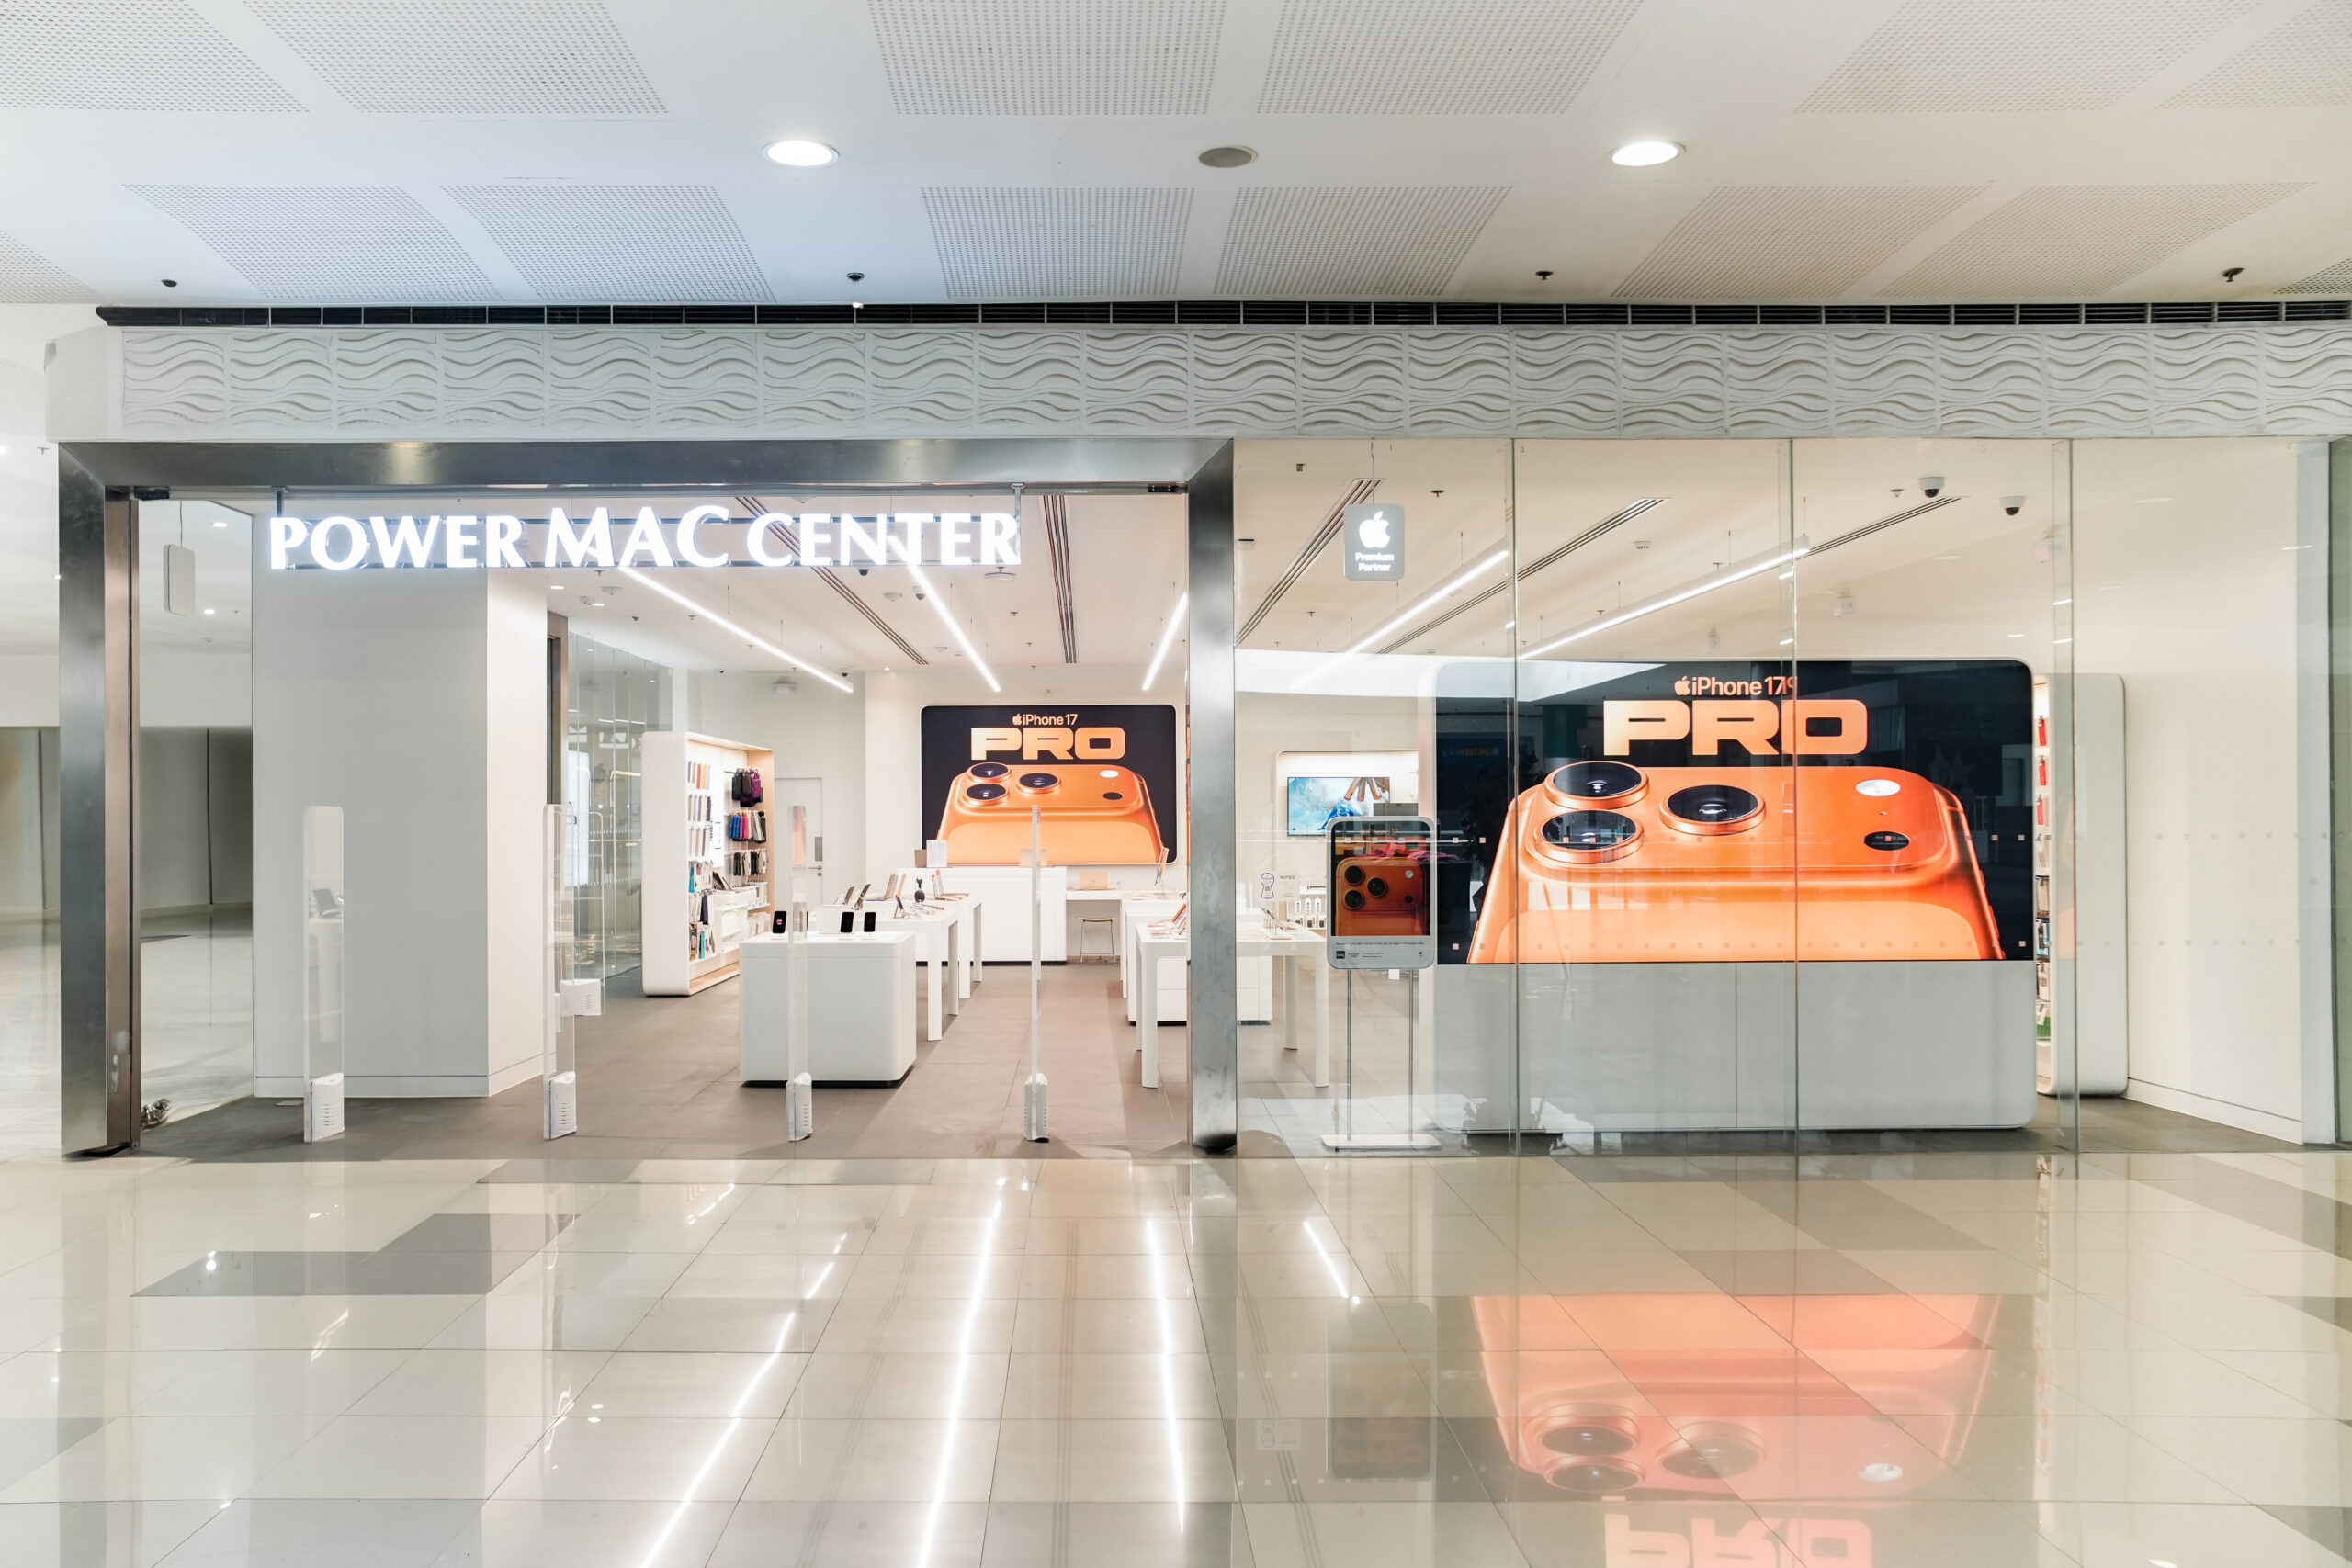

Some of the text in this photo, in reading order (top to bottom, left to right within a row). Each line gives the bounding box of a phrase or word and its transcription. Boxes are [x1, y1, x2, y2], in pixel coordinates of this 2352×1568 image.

[270, 505, 1021, 570] POWER MAC CENTER
[1355, 552, 1395, 561] Premium
[1358, 562, 1391, 571] Partner
[1692, 676, 1762, 695] iPhone
[1023, 713, 1078, 726] iPhone 17
[1603, 699, 1868, 756] PRO
[971, 727, 1125, 761] PRO
